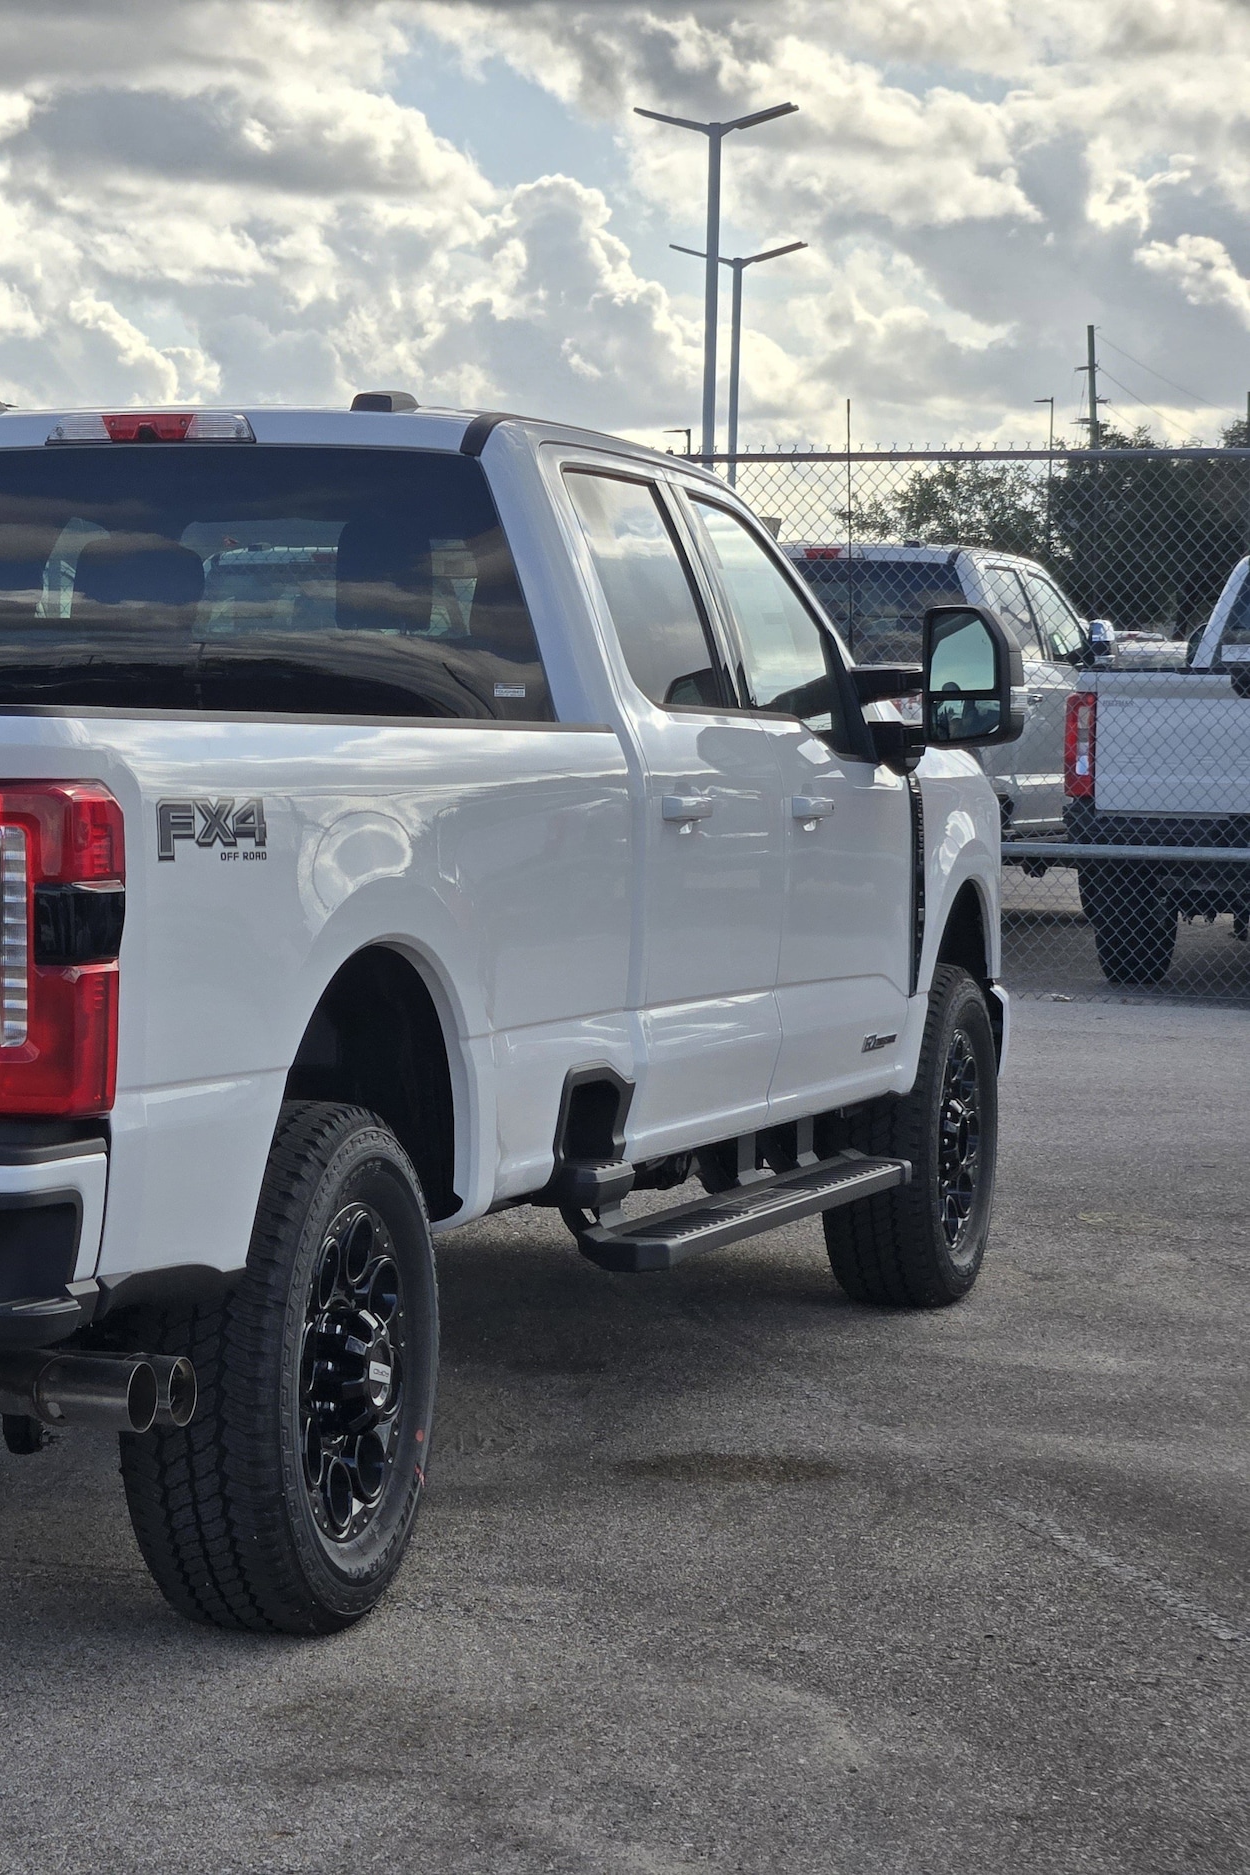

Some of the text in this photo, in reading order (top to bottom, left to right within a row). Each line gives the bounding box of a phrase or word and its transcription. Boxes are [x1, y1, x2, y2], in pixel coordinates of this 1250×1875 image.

[156, 798, 267, 862] FX4
[220, 851, 267, 861] OFF ROAD
